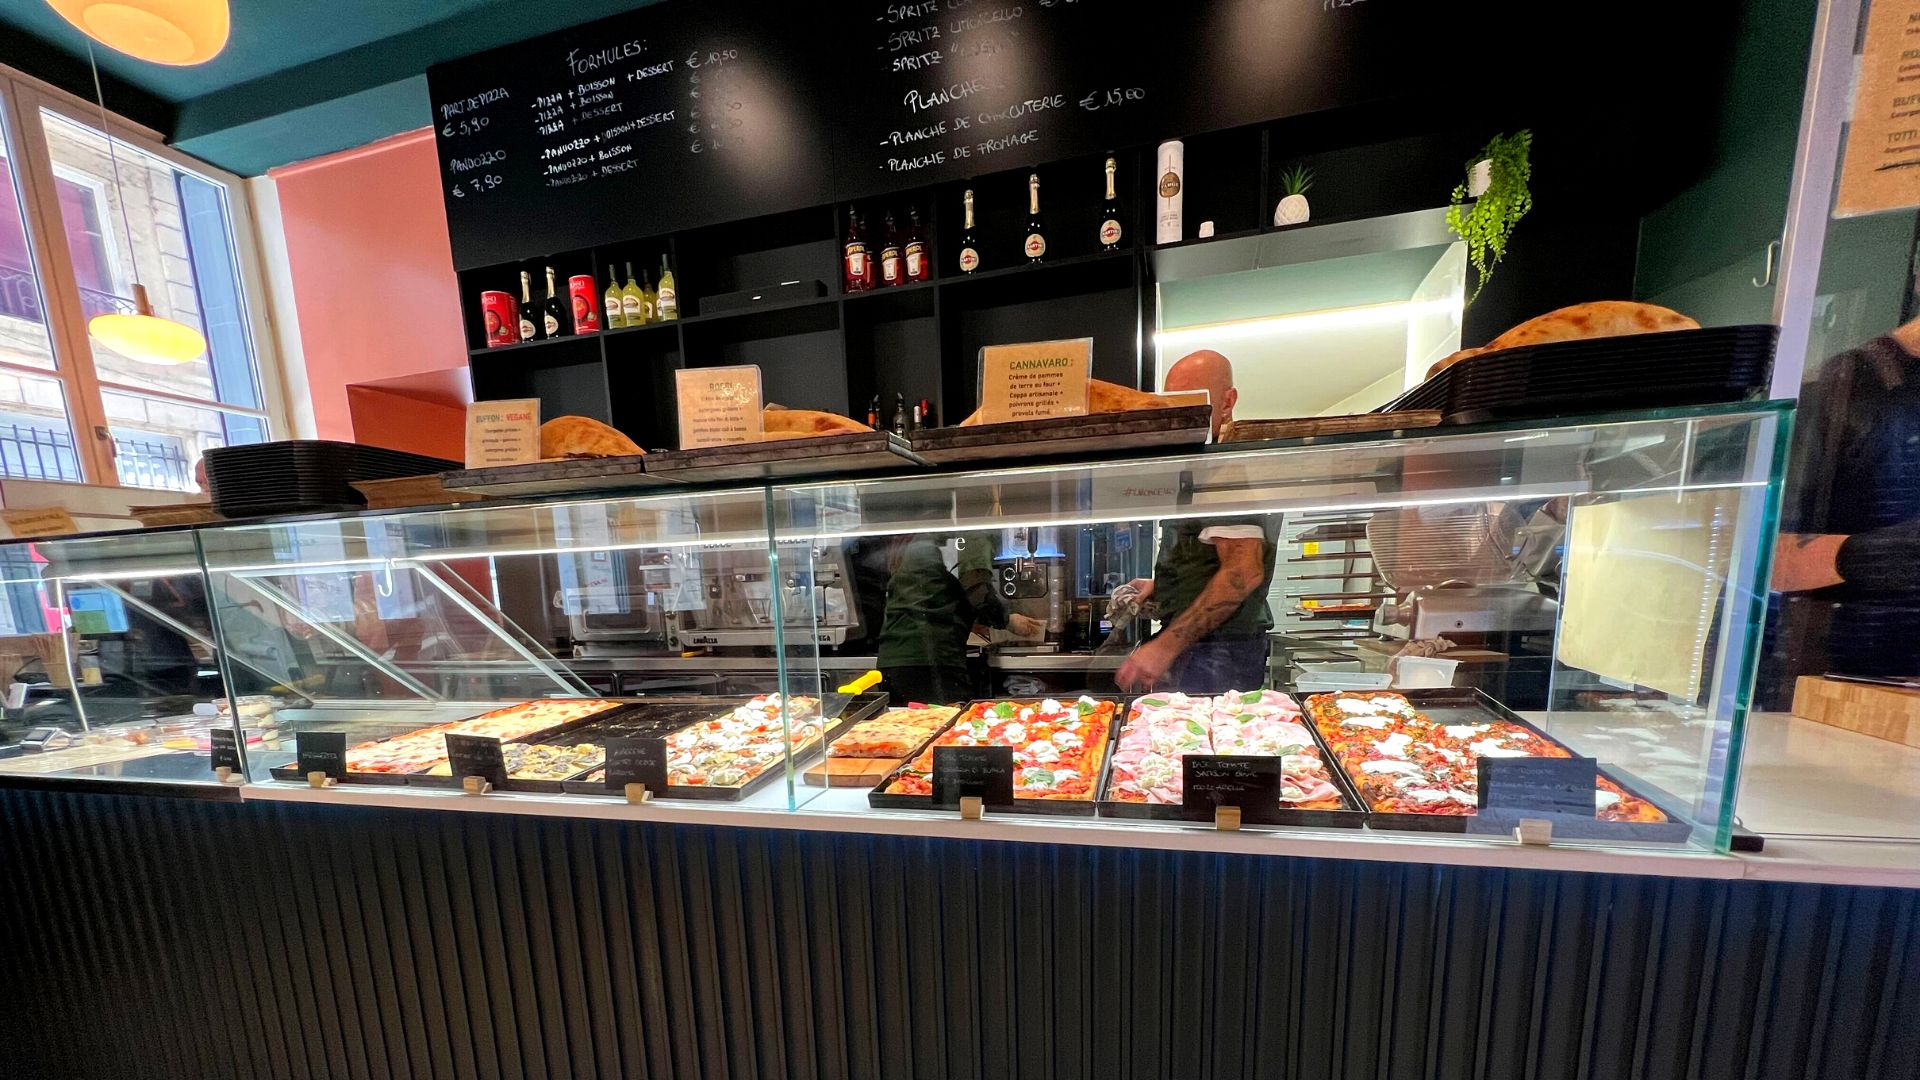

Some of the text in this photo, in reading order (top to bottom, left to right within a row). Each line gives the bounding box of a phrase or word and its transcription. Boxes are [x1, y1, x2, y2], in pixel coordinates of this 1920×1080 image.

[888, 26, 940, 51] SPRITZ
[892, 51, 943, 72] SPRITZ
[577, 77, 616, 96] BOISSON
[636, 60, 674, 80] DESSERT
[579, 90, 614, 107] BOISSON
[440, 99, 465, 120] PART
[581, 102, 623, 121] DESSERT
[459, 117, 490, 136] 5,90
[953, 116, 971, 132] DE
[887, 151, 946, 172] PLANCHE
[952, 145, 970, 160] DE
[977, 129, 1039, 156] FROMAGE
[601, 158, 639, 178] DESSERT
[470, 174, 503, 192] 7,90
